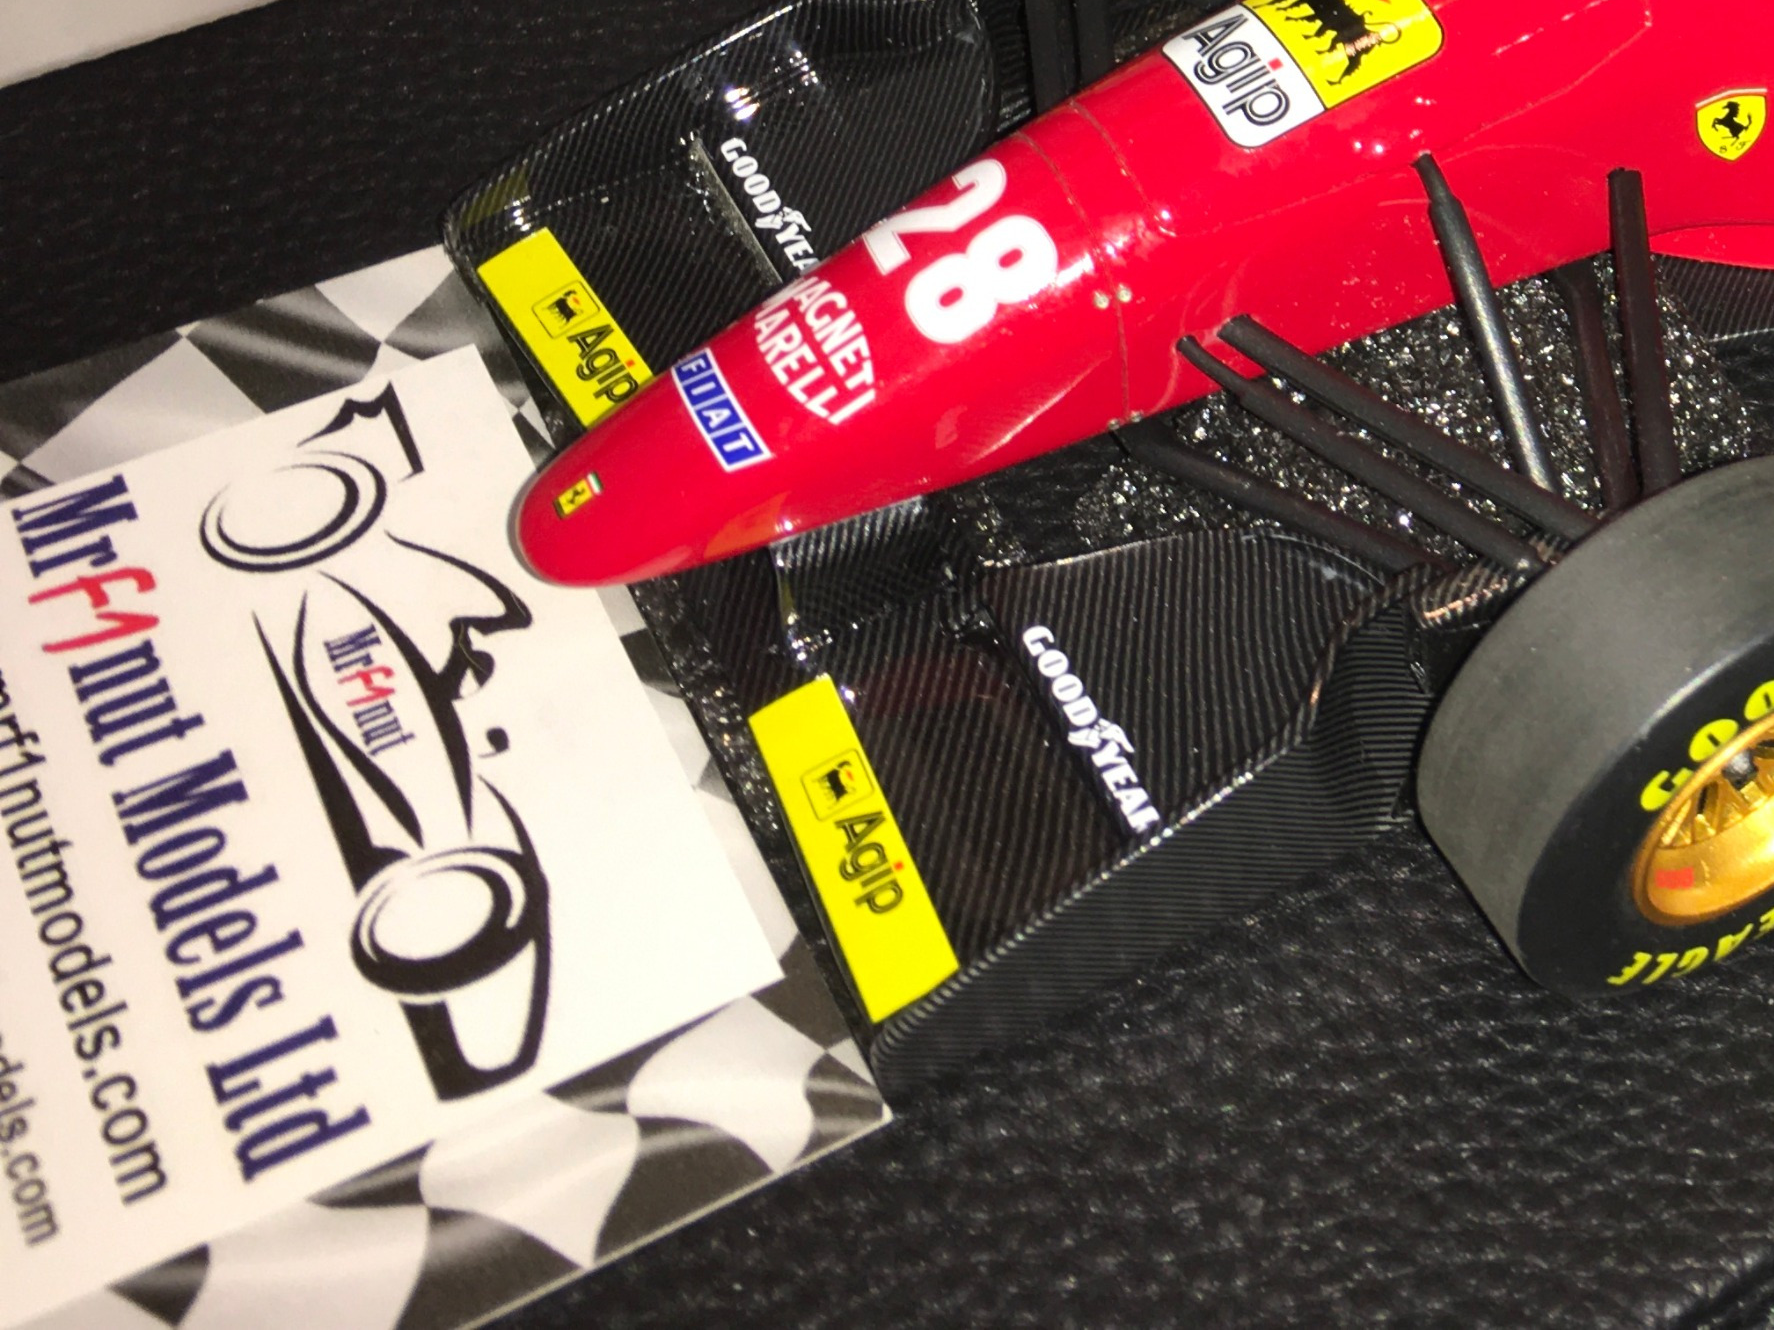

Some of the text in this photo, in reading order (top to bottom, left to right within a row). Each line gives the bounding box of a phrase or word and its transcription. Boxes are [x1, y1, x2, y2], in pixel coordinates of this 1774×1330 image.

[1182, 12, 1291, 128] Agip
[720, 137, 820, 274] GOODYEA
[862, 157, 1058, 345] 28
[566, 322, 640, 405] Agip
[676, 354, 764, 466] FIAT
[1021, 625, 1162, 835] GOODYEAR
[111, 747, 305, 1034] Models
[834, 810, 906, 916] Agip
[0, 1030, 60, 1248] dels.com
[205, 1014, 371, 1182] Ltd
